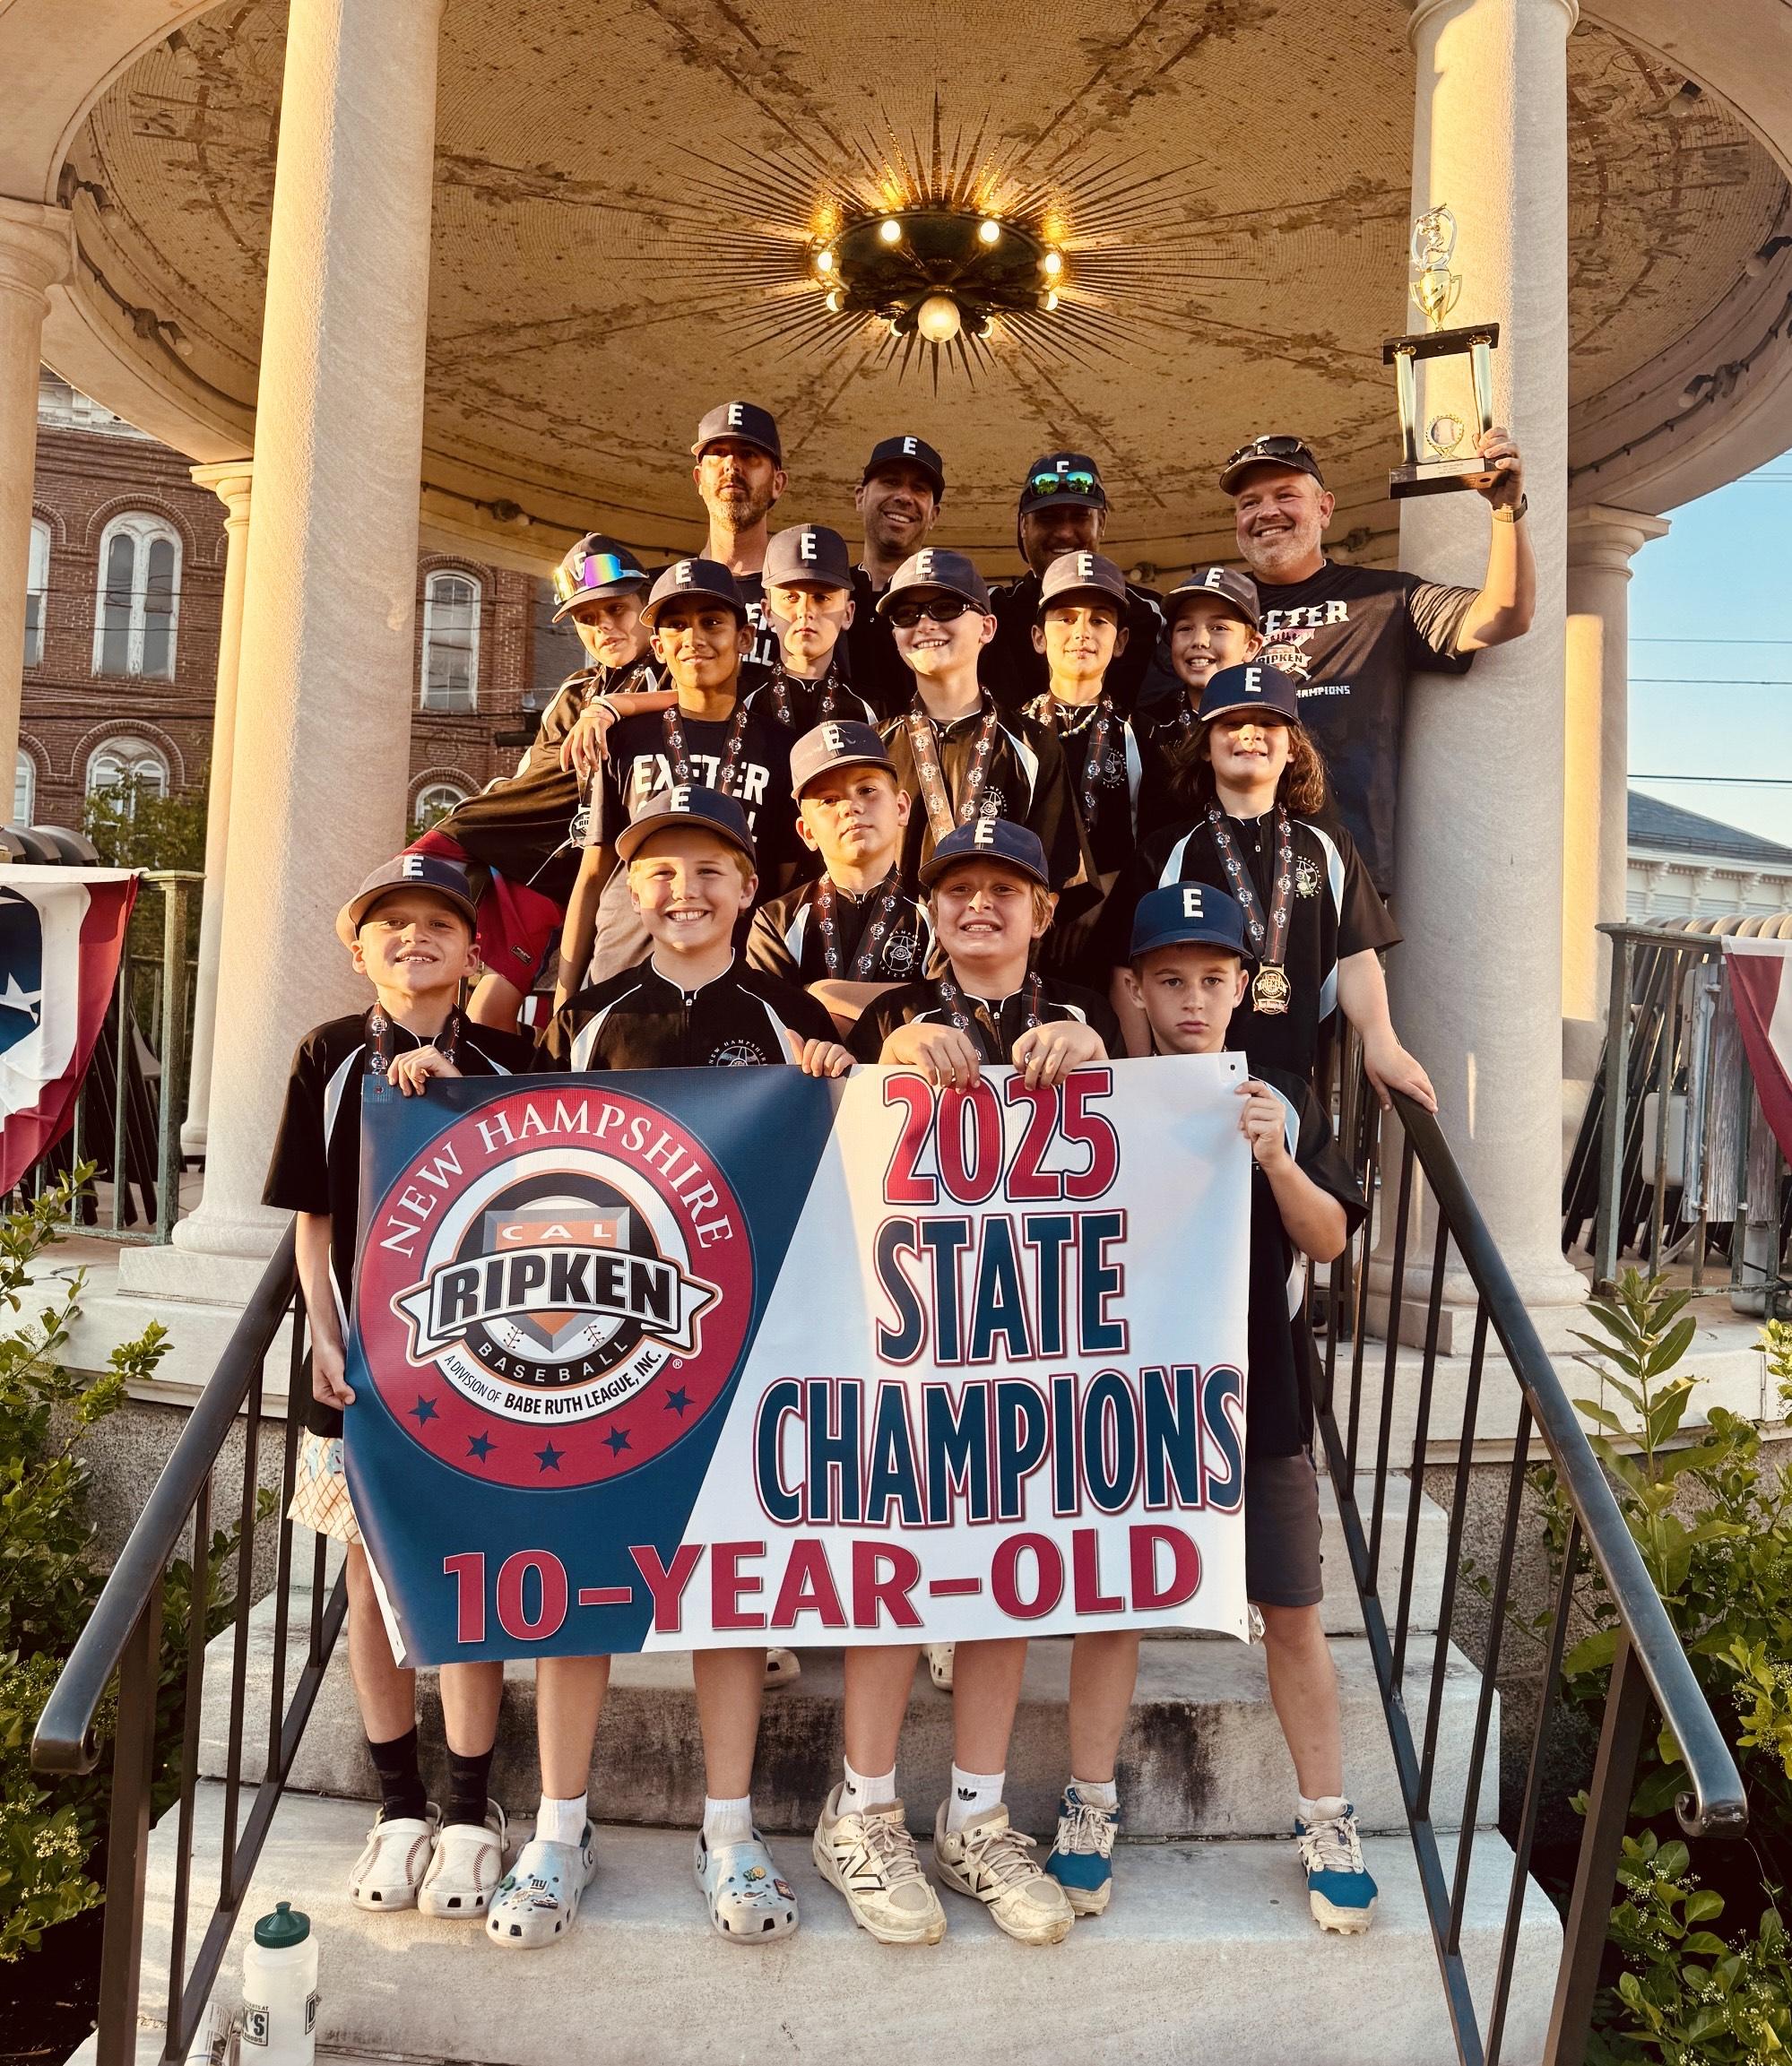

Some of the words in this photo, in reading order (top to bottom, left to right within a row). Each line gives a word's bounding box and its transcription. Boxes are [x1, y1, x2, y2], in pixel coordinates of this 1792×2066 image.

[728, 403, 743, 426] E
[903, 437, 918, 455] E
[801, 532, 818, 560] E
[675, 561, 694, 584] E
[915, 550, 934, 575] E
[1077, 553, 1094, 576] E
[1204, 567, 1225, 588] E
[1260, 600, 1350, 636] ETER
[1244, 667, 1262, 693] E
[822, 724, 845, 750] E
[670, 786, 692, 812] E
[974, 817, 997, 843] E
[403, 852, 424, 877] E
[1182, 885, 1204, 918] E
[882, 1067, 1121, 1206] 2025
[379, 1141, 465, 1258] NEW
[475, 1099, 734, 1249] HAMPSHIRE
[501, 1223, 612, 1240] CAL
[438, 1251, 673, 1325] RIPKEN
[873, 1208, 1130, 1367] STATE
[478, 1342, 628, 1382] BASEBALL
[444, 1354, 455, 1366] A
[450, 1359, 489, 1396] DIVISION
[486, 1387, 502, 1403] OF
[504, 1392, 541, 1415] BABE
[544, 1396, 584, 1415] RUTH
[584, 1371, 640, 1408] LEAGUE,
[633, 1350, 662, 1378] INC.
[752, 1363, 1245, 1527] CHAMPIONS
